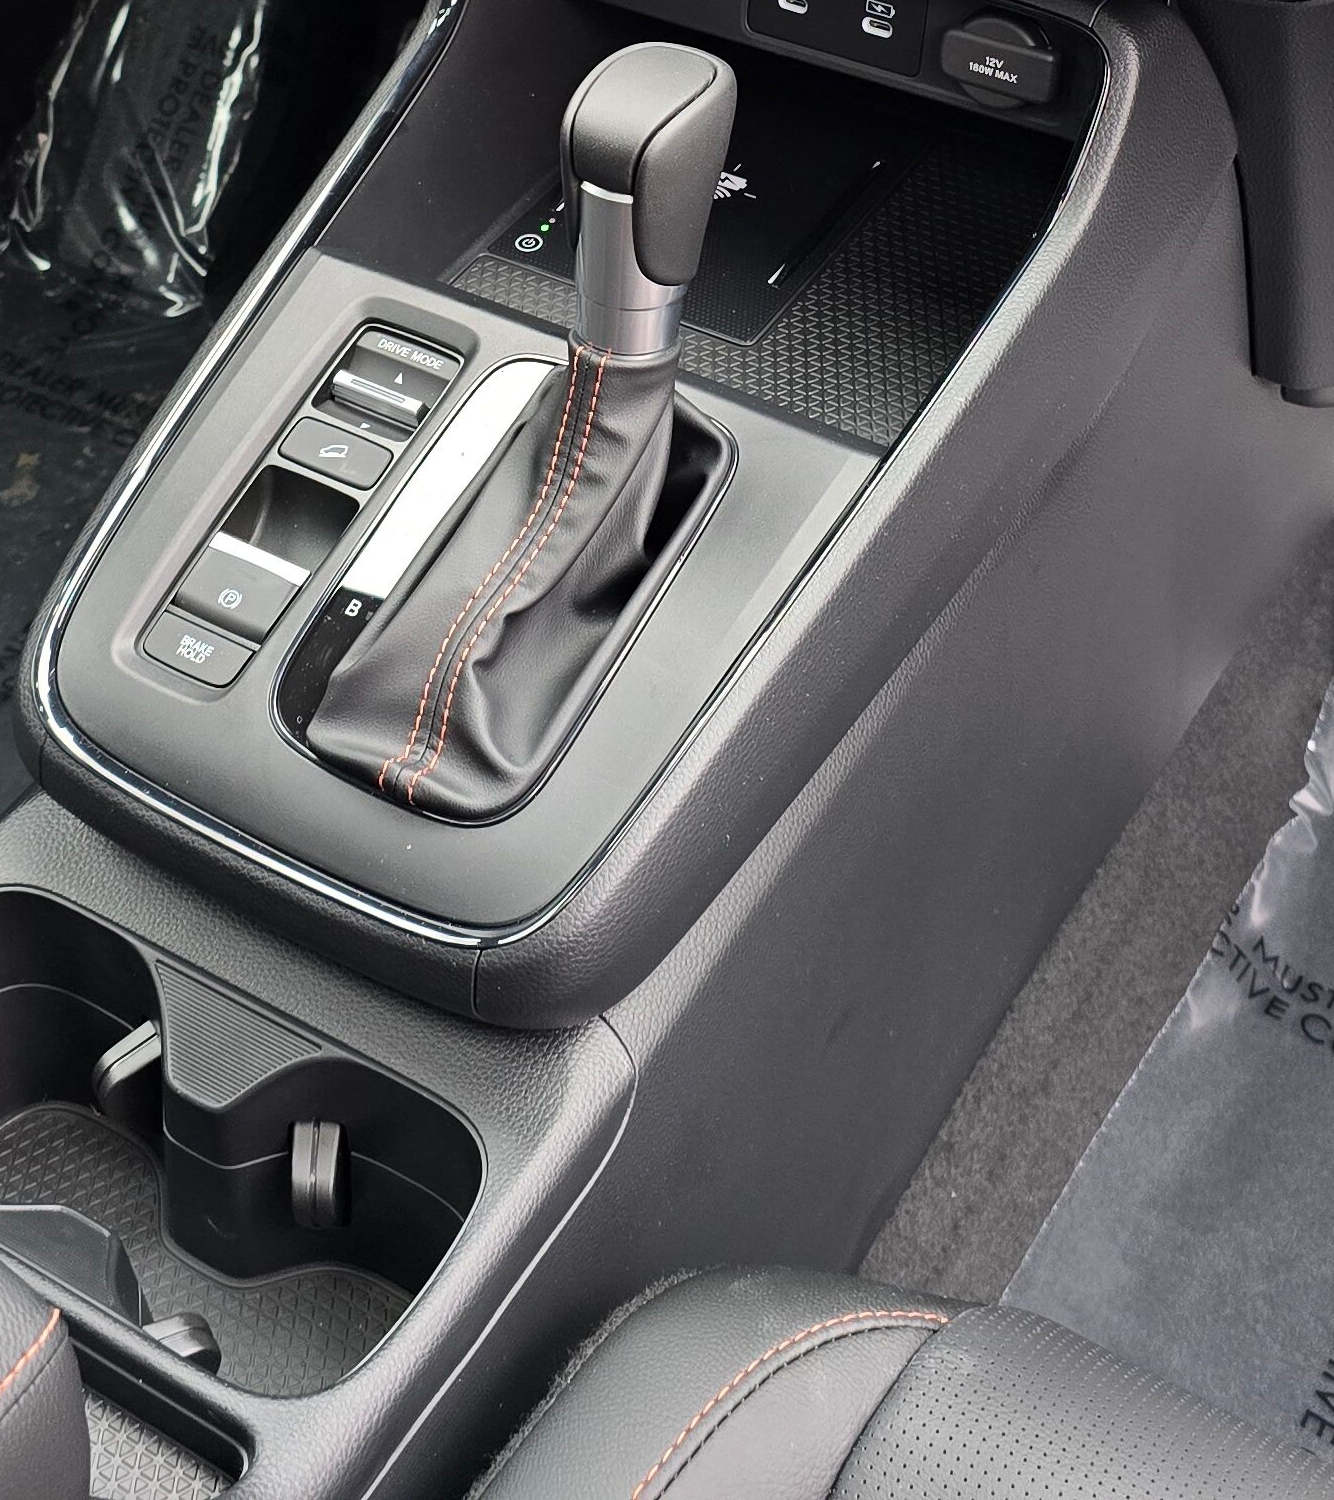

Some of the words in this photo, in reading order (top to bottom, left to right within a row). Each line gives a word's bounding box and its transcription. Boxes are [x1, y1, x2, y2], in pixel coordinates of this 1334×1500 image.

[969, 61, 994, 77] 180W
[994, 69, 1018, 84] MAX
[985, 56, 1004, 69] 12V
[377, 338, 409, 359] DRIVE
[411, 349, 444, 369] MODE
[344, 599, 362, 617] B
[176, 644, 206, 664] HOLD
[180, 635, 214, 657] BRAKE
